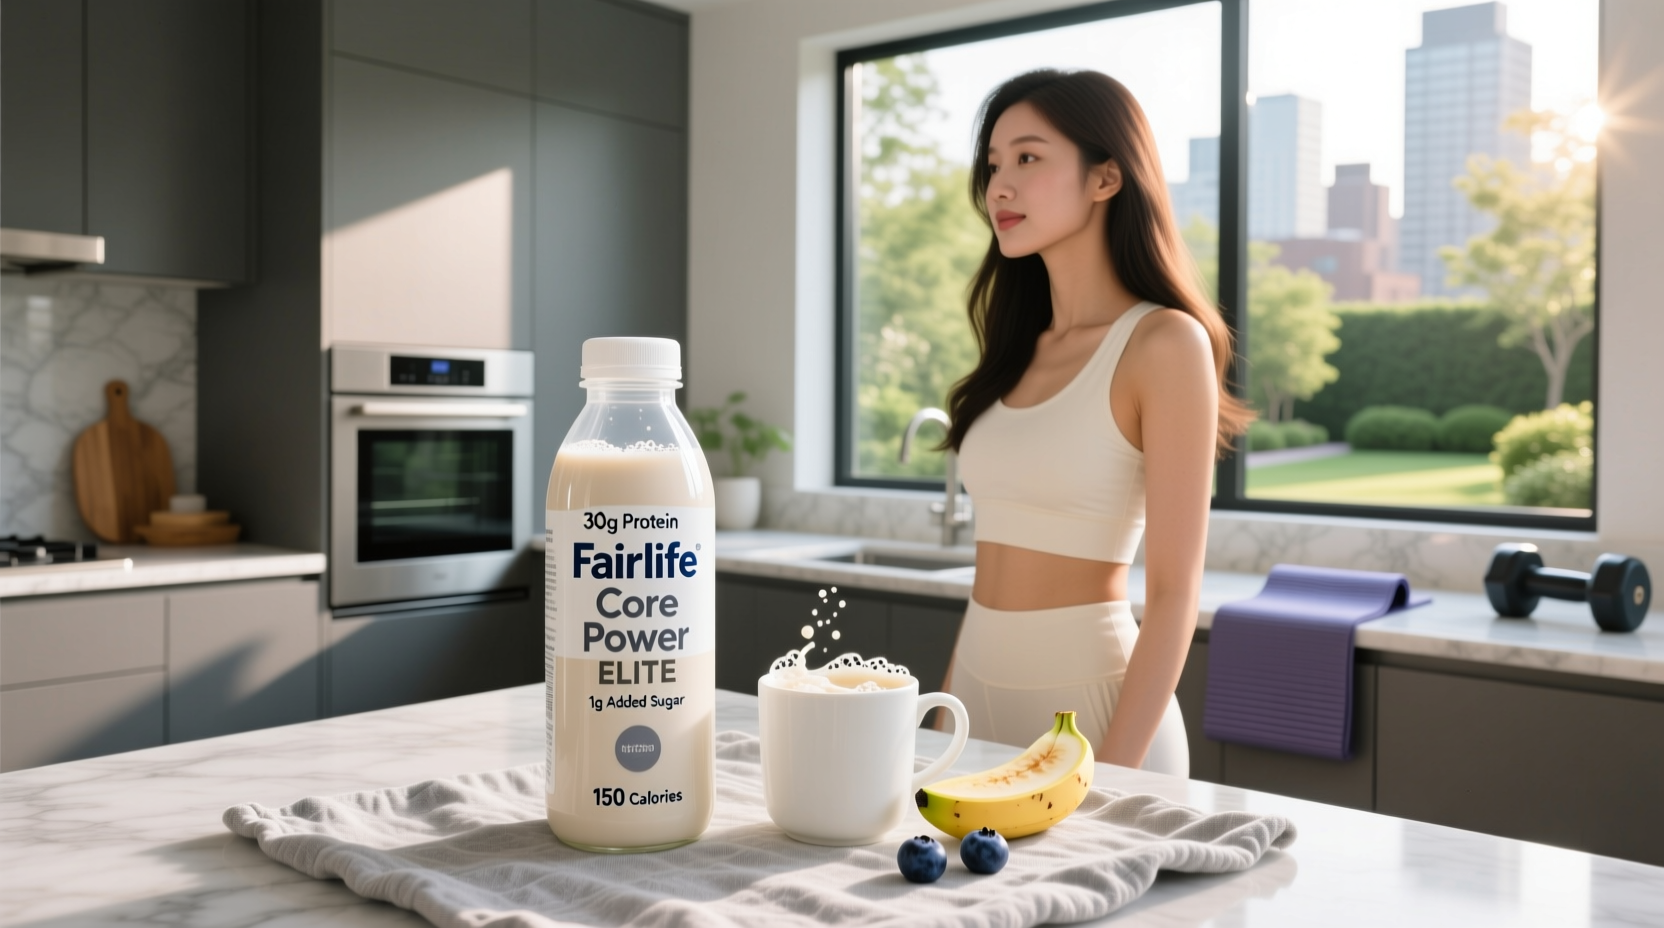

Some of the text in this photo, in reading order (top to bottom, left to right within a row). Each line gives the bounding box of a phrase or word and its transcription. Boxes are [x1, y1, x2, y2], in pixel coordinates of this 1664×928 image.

[583, 511, 678, 534] 30g Protein
[573, 541, 698, 579] Fairlife
[596, 587, 679, 619] Core
[583, 622, 690, 652] Power
[598, 659, 676, 685] ELITE
[588, 694, 685, 711] 1g Added Sugar
[593, 787, 683, 806] 150 Calories
